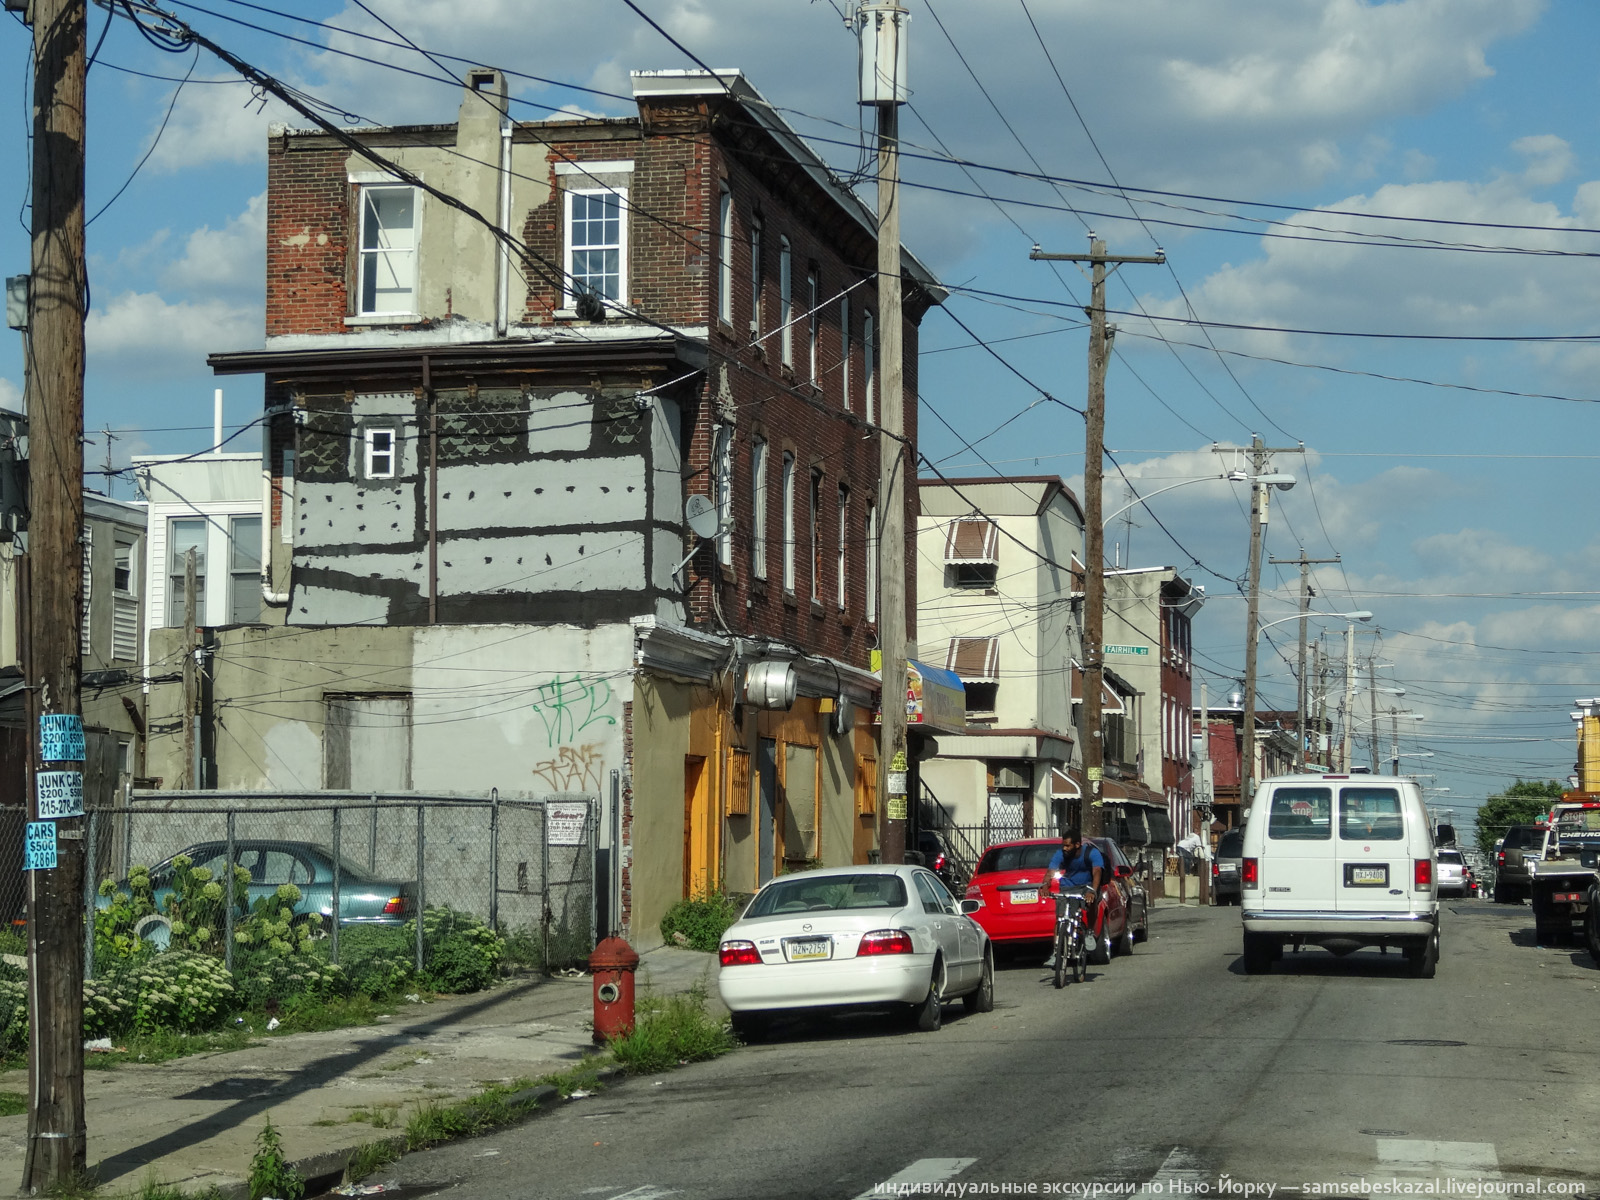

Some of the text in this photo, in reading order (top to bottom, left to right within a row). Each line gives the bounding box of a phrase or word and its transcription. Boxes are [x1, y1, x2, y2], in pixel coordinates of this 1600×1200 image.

[1106, 646, 1139, 655] FAIRHILL
[42, 716, 67, 732] JUNK
[43, 732, 66, 744] $200
[70, 733, 84, 744] $500
[40, 774, 65, 789] JUNK
[40, 788, 63, 799] $200
[1291, 807, 1313, 815] STOP
[1563, 812, 1585, 822] STOP
[28, 823, 54, 840] CARS
[30, 840, 54, 852] $500
[792, 942, 826, 955] HZN-2759
